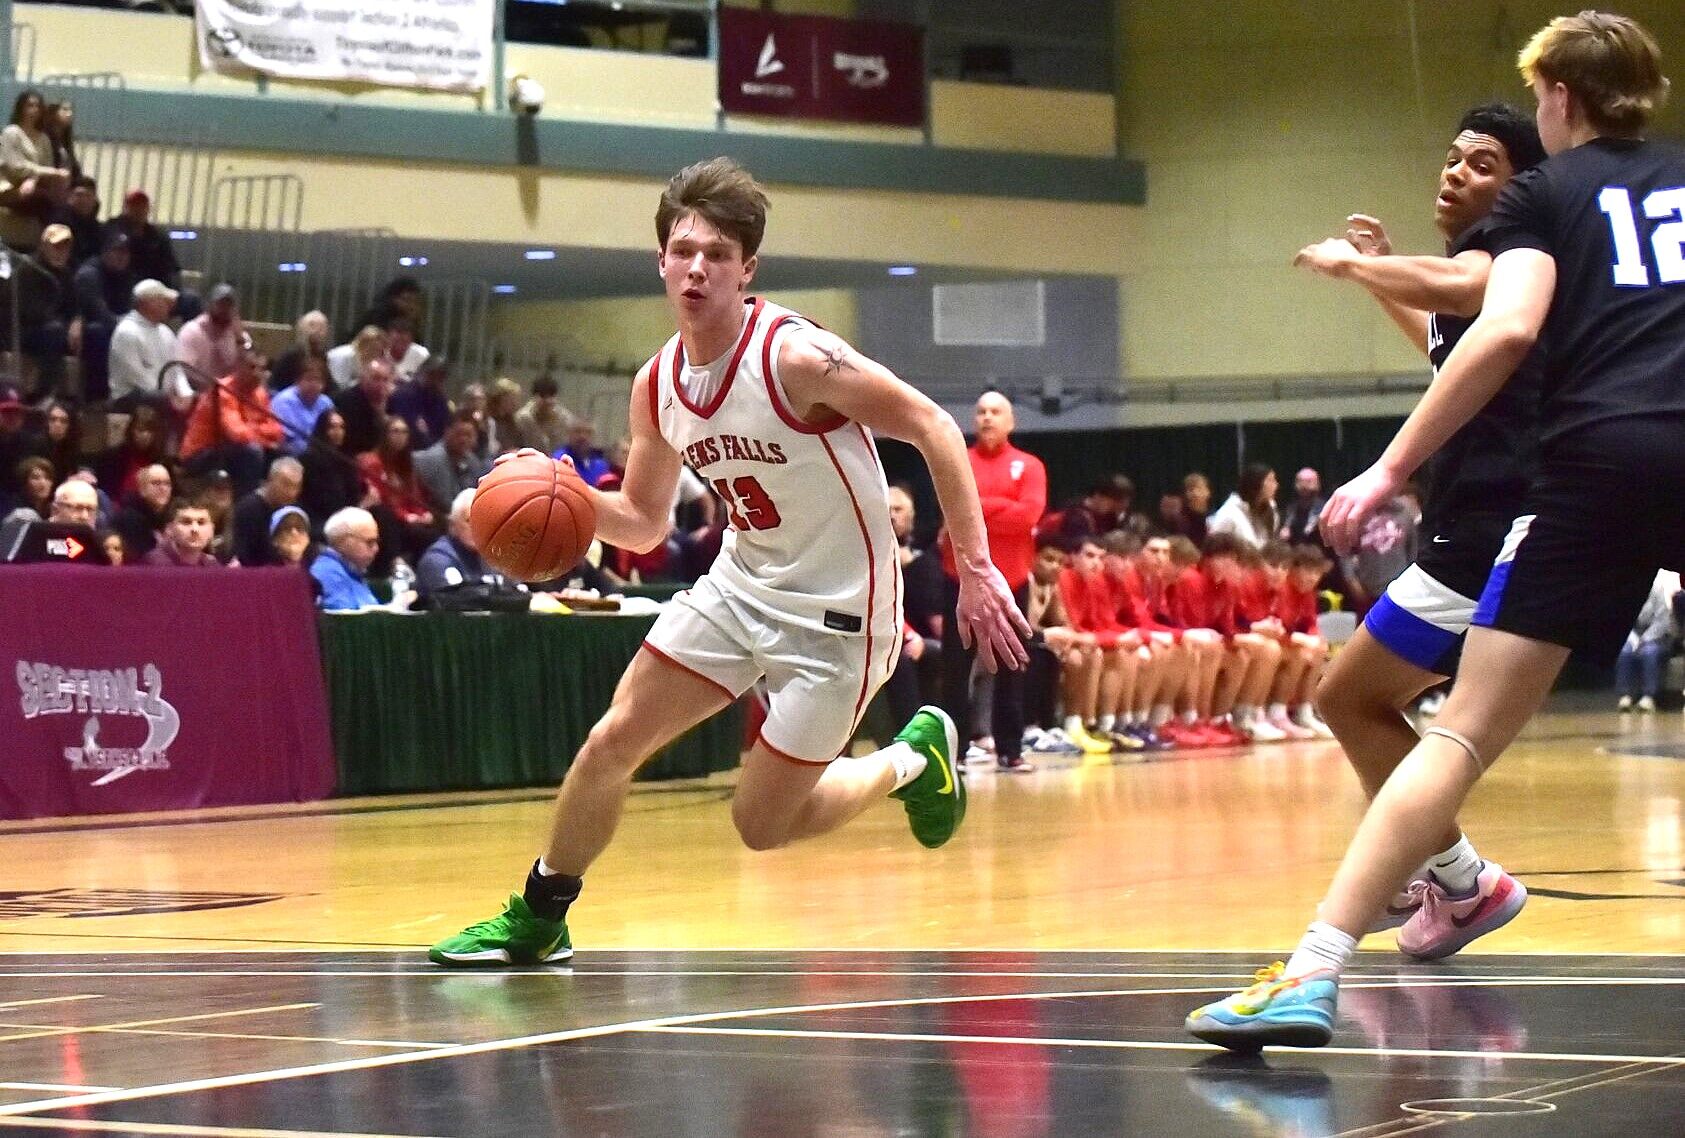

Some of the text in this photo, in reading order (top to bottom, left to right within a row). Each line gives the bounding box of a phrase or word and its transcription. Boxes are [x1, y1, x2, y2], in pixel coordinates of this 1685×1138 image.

[1598, 185, 1685, 288] 12
[680, 434, 788, 470] ENS FALLS
[713, 475, 781, 532] 13
